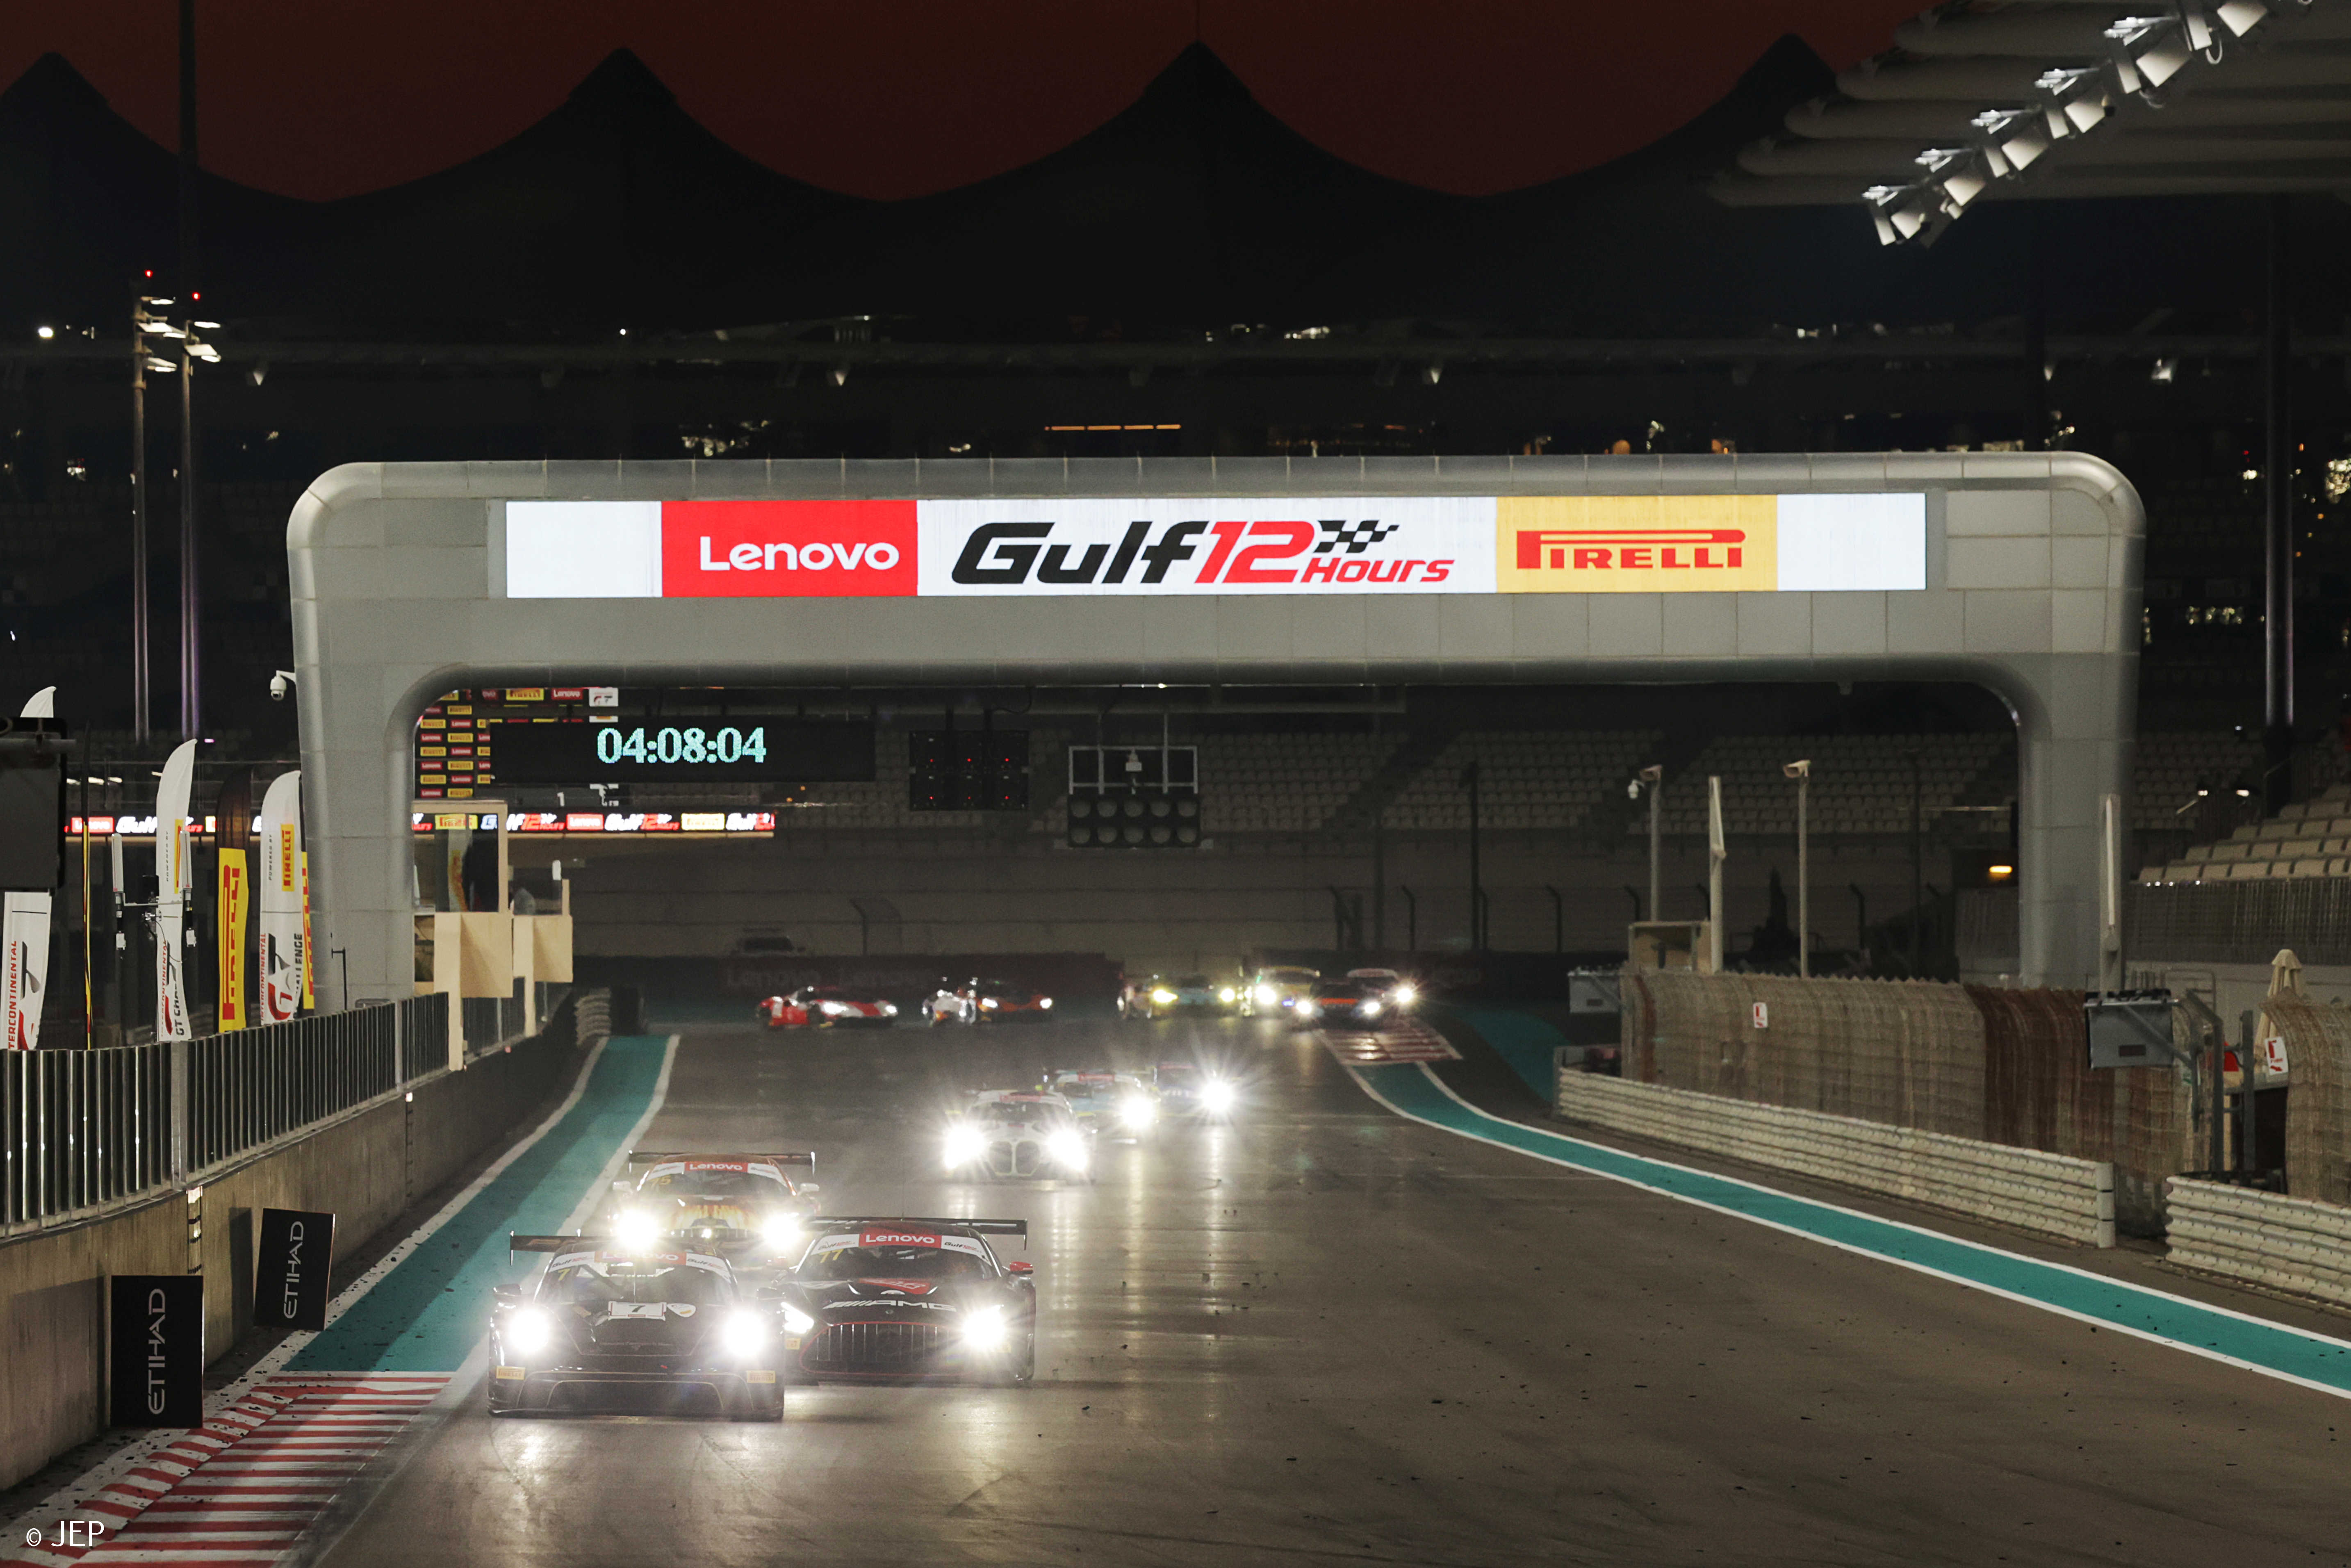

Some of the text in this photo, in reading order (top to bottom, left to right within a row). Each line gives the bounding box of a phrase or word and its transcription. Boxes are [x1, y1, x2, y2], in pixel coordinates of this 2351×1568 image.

[700, 536, 899, 570] Lenovo
[1517, 529, 1746, 569] PIRELLI
[1300, 558, 1455, 583] Hours
[597, 727, 766, 763] 04:08:04
[570, 816, 601, 827] Lenovo
[282, 830, 291, 886] PIRELLI
[8, 941, 17, 1049] TERCONTINENTAL
[866, 1233, 935, 1244] Lenovo
[283, 1220, 304, 1319] ETIHAD
[820, 1249, 844, 1263] 77
[558, 1268, 571, 1281] 7
[628, 1304, 646, 1313] 7
[148, 1288, 165, 1415] ETIHAD
